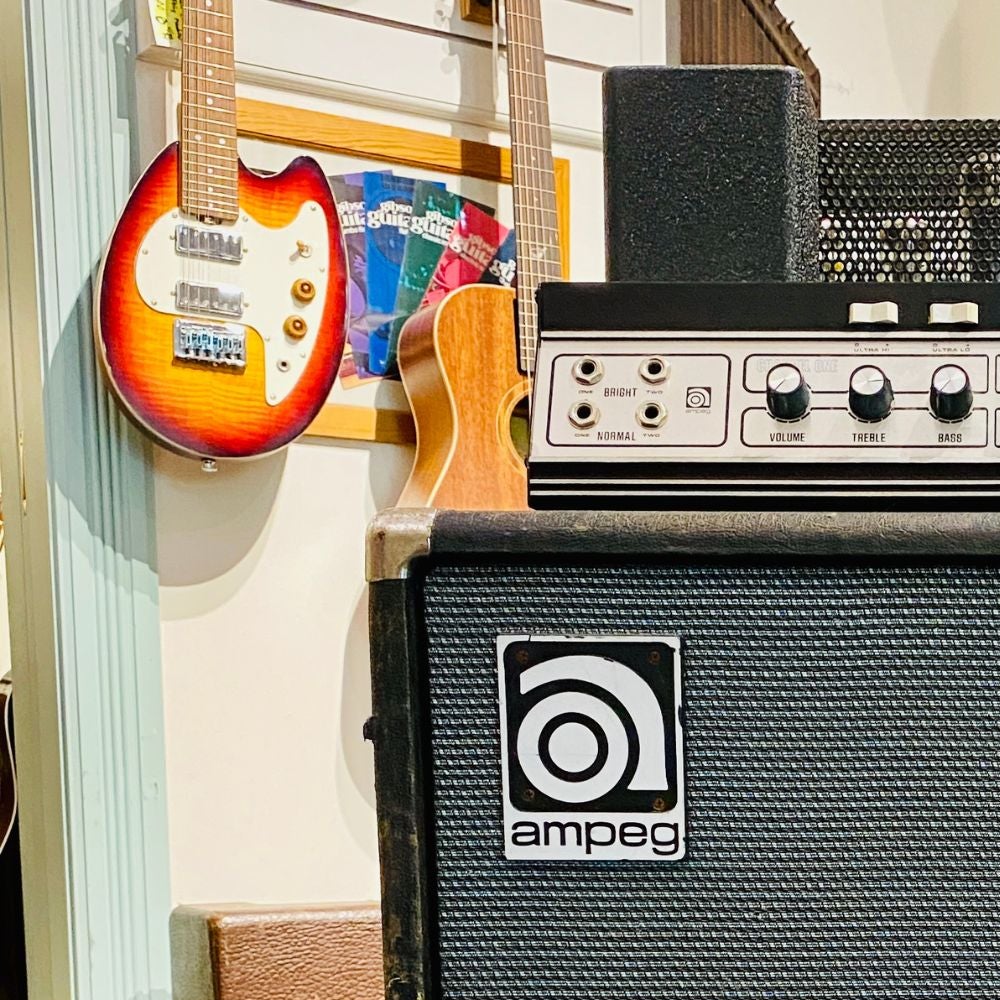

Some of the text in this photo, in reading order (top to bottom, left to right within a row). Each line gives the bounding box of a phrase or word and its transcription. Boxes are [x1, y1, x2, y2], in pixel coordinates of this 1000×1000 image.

[367, 210, 412, 229] guita
[604, 387, 638, 397] BRIGHT
[597, 432, 636, 441] NORMAL
[770, 433, 805, 443] VOLUME
[852, 433, 886, 443] TREBLE
[938, 433, 962, 443] BASS
[511, 820, 679, 856] ampeg
